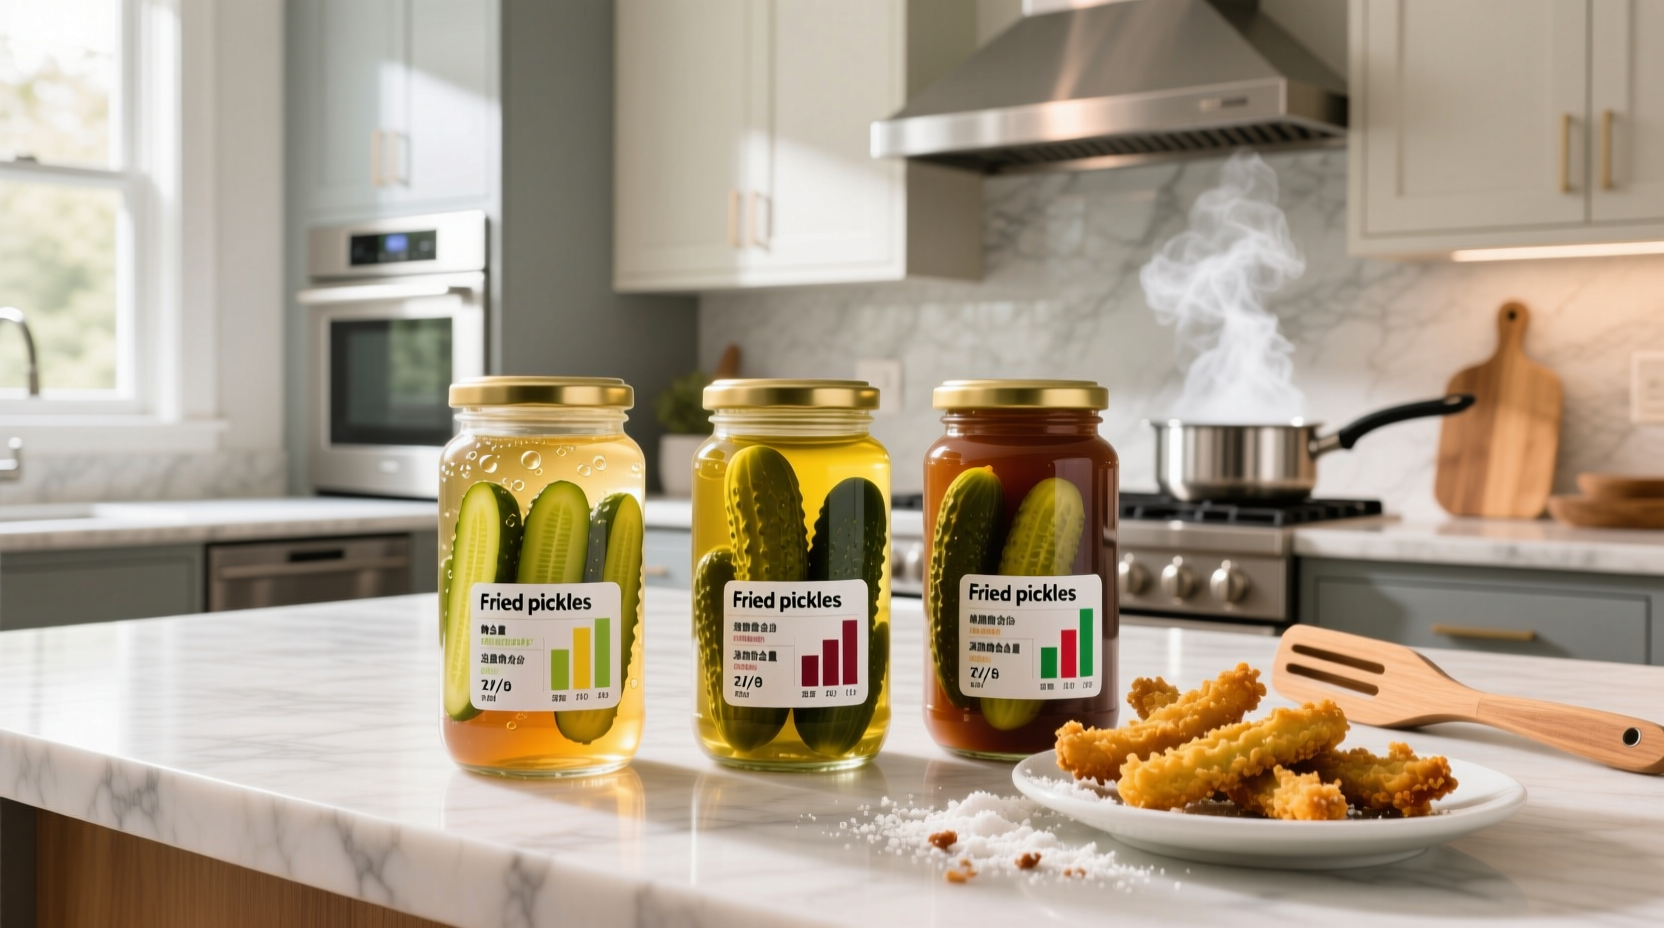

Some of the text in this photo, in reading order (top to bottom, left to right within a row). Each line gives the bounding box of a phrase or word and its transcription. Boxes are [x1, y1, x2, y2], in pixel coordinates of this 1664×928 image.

[480, 592, 592, 615] Fried pickles
[733, 590, 842, 612] Fried pickles
[969, 583, 1077, 606] Fried pickles
